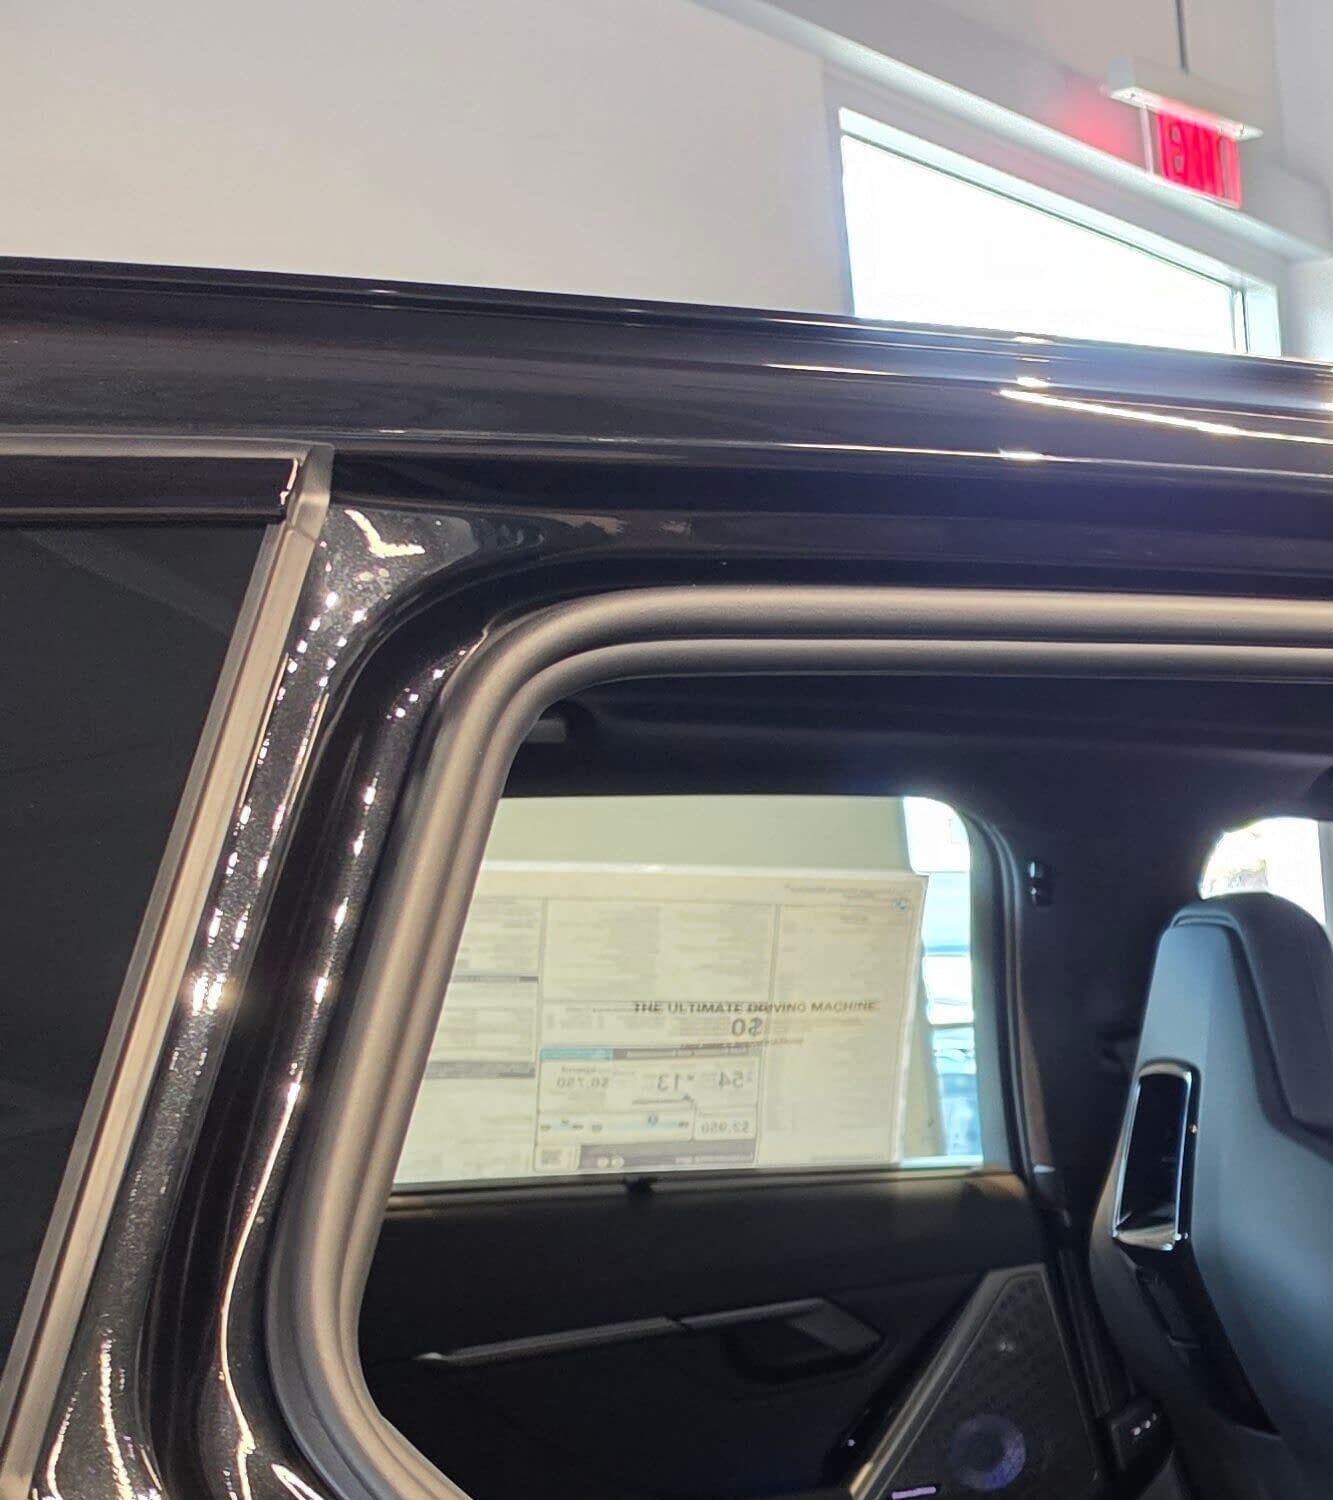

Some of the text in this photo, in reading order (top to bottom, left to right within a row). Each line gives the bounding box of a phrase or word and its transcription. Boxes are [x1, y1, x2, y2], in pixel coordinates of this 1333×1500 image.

[633, 1001, 661, 1013] THE
[667, 1001, 742, 1013] ULTIMATE
[746, 1001, 807, 1013] DRIVING
